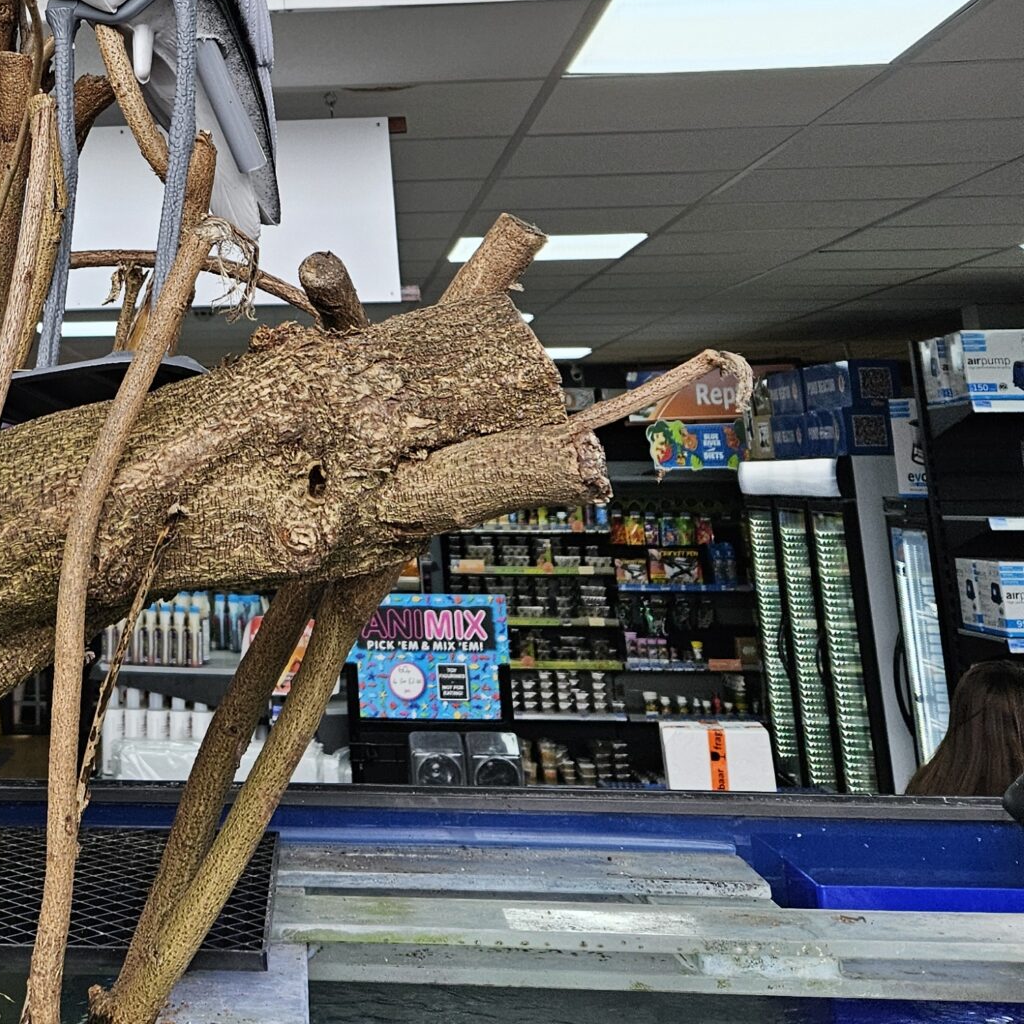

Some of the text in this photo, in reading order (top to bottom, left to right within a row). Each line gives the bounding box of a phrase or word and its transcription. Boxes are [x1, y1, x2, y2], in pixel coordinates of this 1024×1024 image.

[967, 357, 1011, 367] airpump
[361, 608, 488, 641] ANIMIX
[366, 640, 395, 650] PICK
[421, 641, 430, 651] &
[433, 641, 456, 652] MIX
